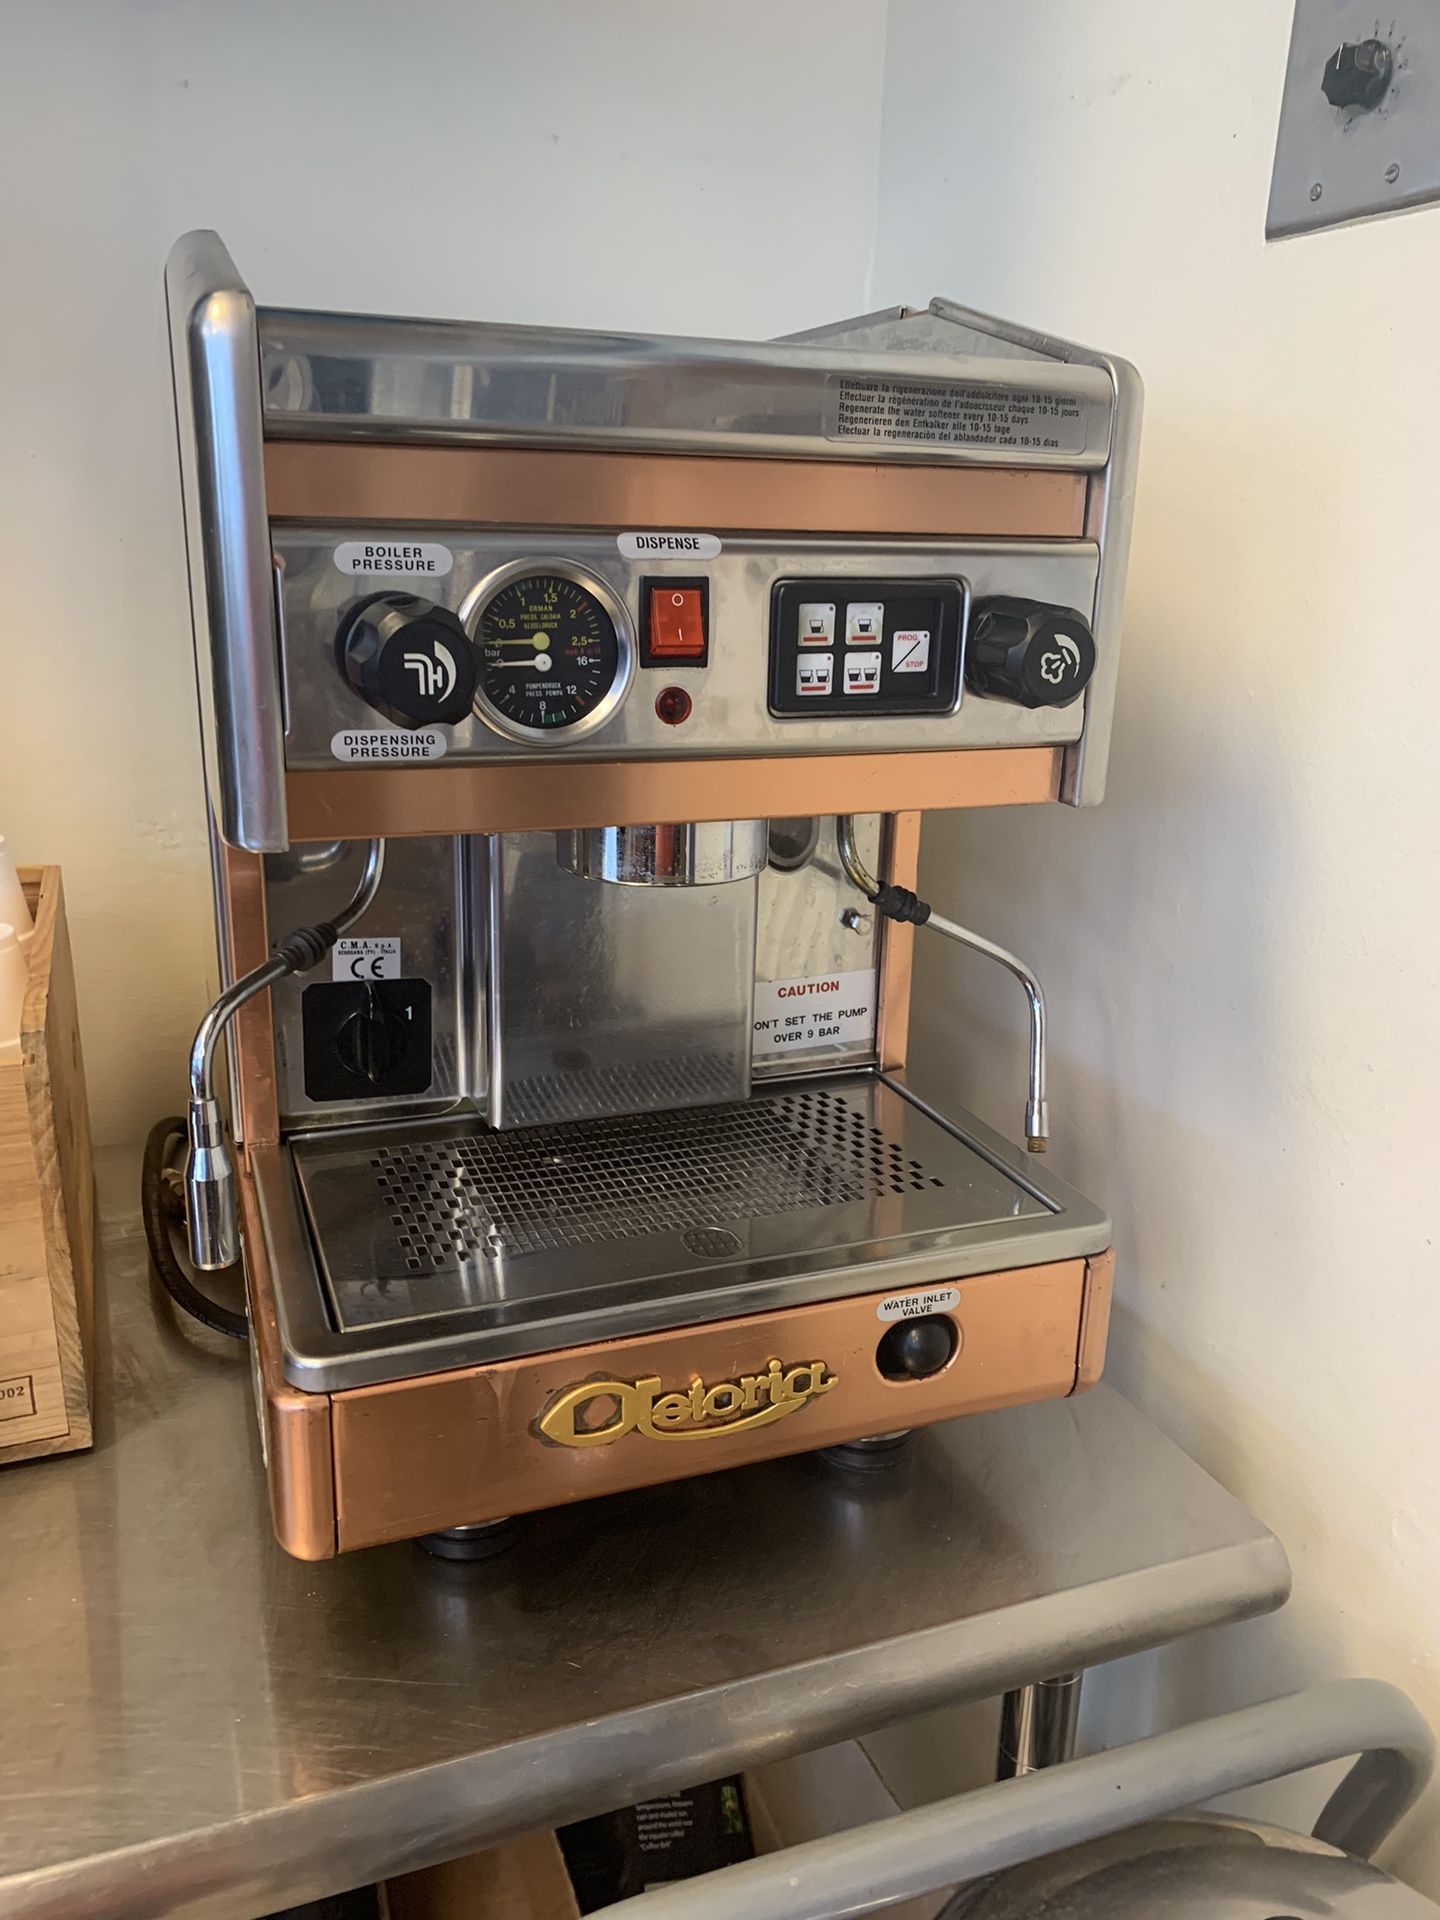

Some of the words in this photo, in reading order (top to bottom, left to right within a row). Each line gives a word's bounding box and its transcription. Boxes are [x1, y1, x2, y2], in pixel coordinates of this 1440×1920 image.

[882, 383, 889, 392] la
[840, 391, 875, 402] Effectuer
[878, 394, 886, 403] la
[942, 398, 952, 408] de
[954, 400, 1006, 412] l'adoucisseur
[1008, 404, 1034, 414] chaque
[1038, 406, 1058, 416] 10-15
[1060, 408, 1080, 418] jours
[840, 402, 885, 414] Regenerate
[888, 406, 900, 416] the
[904, 408, 926, 418] water
[928, 409, 960, 420] softener
[963, 413, 984, 423] every
[988, 412, 1008, 423] 10-15
[1011, 415, 1028, 426] days
[838, 414, 892, 426] Regenerieren
[895, 416, 910, 427] den
[912, 418, 950, 430] Entkalker
[952, 422, 966, 431] alle
[970, 422, 992, 433] 10-15
[994, 424, 1010, 435] tage
[838, 424, 870, 436] Efectuar
[873, 427, 880, 436] la
[938, 431, 950, 441] del
[954, 433, 997, 444] ablandador
[999, 436, 1016, 445] cada
[1020, 436, 1041, 446] 10-15
[636, 535, 700, 550] DISPENSE
[364, 546, 423, 559] BOILER
[352, 558, 436, 572] PRESSURE
[570, 608, 577, 619] 2
[498, 618, 516, 630] 0,5
[571, 636, 588, 647] 2,5
[484, 648, 501, 657] bar
[576, 656, 588, 666] 16
[906, 660, 924, 668] STOP
[508, 684, 516, 695] 4
[566, 684, 577, 695] 12
[539, 700, 546, 710] 8
[344, 734, 436, 746] DISPENSING
[350, 746, 430, 758] PRESSURE
[778, 980, 840, 998] CAUTION
[405, 1006, 412, 1020] 1
[754, 1019, 779, 1030] ON'T
[785, 1015, 806, 1026] SET
[812, 1012, 833, 1022] THE
[838, 1007, 868, 1019] PUMP
[774, 1031, 802, 1043] OVER
[807, 1029, 814, 1038] 9
[818, 1026, 840, 1037] BAR
[884, 1298, 918, 1311] WATER
[924, 1292, 952, 1304] INLET
[902, 1304, 932, 1317] VALVE
